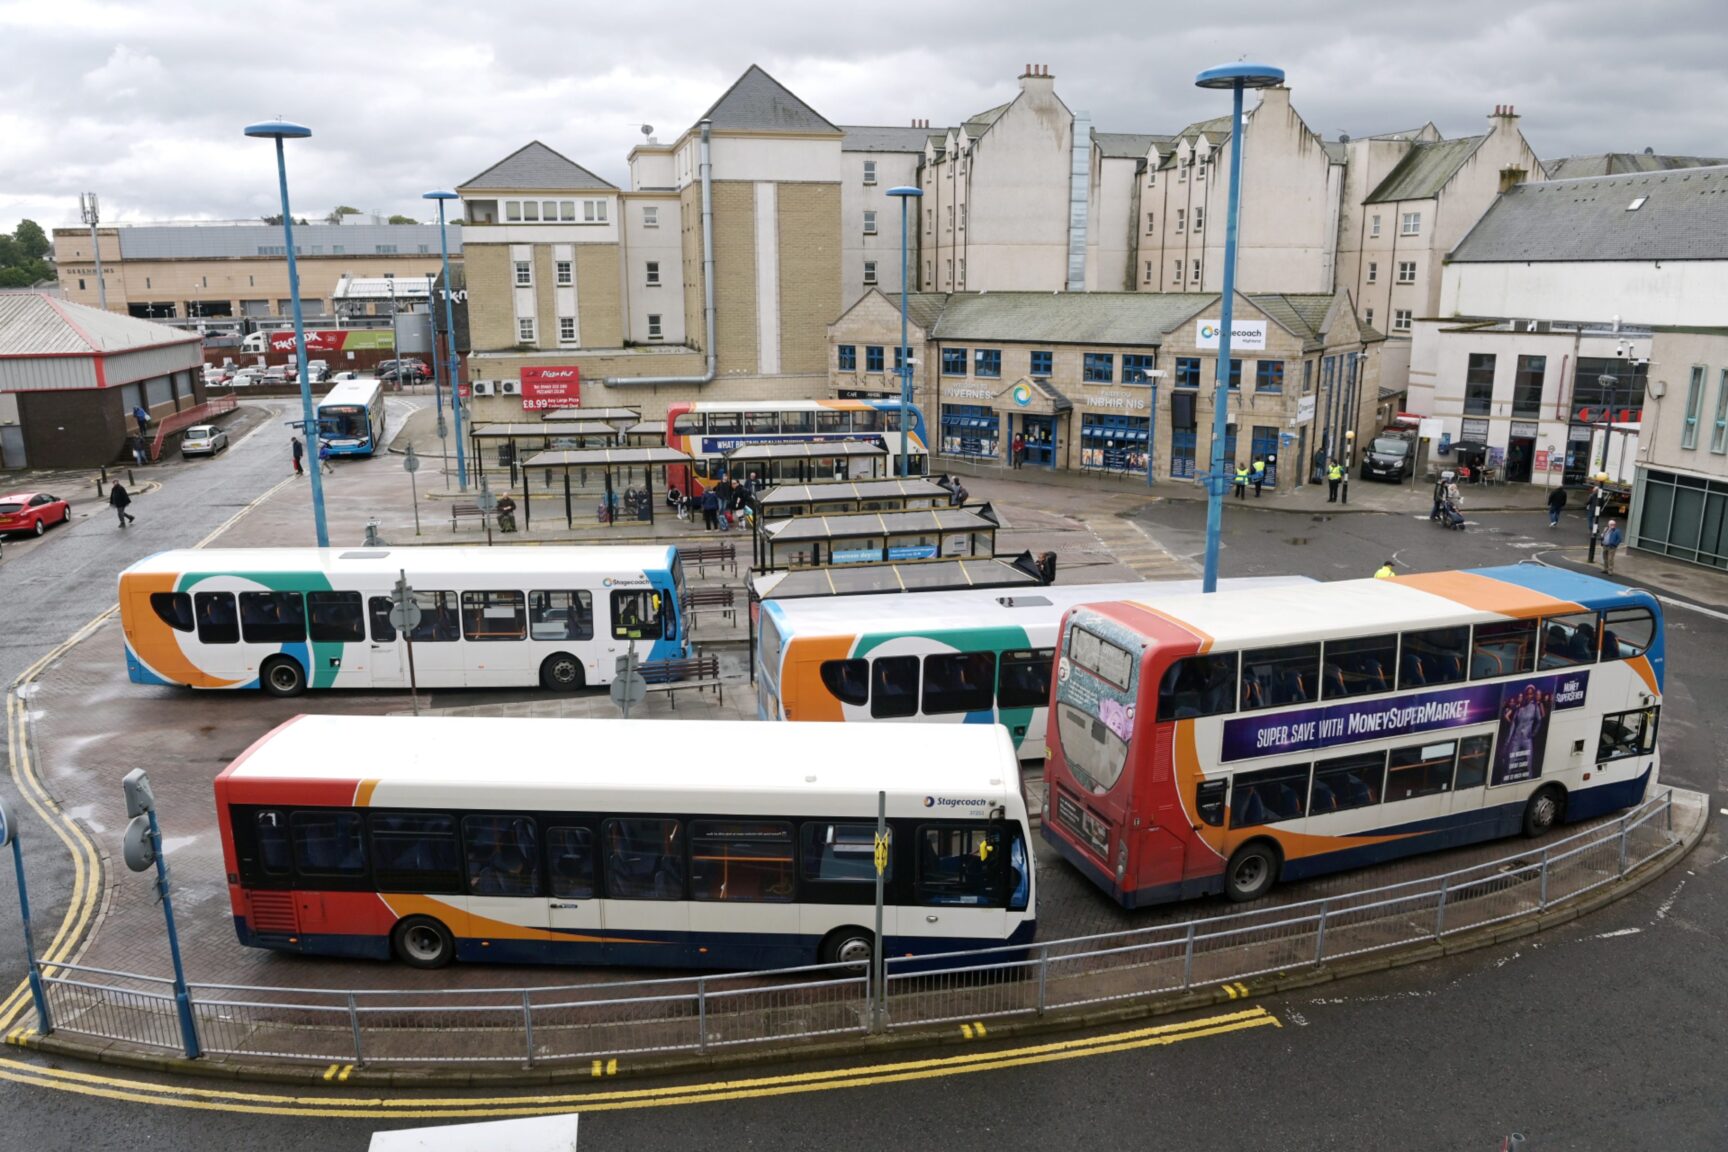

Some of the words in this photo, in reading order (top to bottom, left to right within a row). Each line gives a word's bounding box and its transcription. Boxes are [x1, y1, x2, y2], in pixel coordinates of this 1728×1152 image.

[1213, 328, 1262, 337] Secoach
[523, 399, 548, 408] £8.99
[1087, 396, 1122, 408] INBHIR
[1125, 399, 1145, 409] NIS
[717, 440, 734, 449] WHAT
[1257, 726, 1288, 748] SUPER
[1291, 722, 1316, 743] SAVE
[1319, 718, 1344, 738] WITH
[938, 797, 986, 808] Stagecoach
